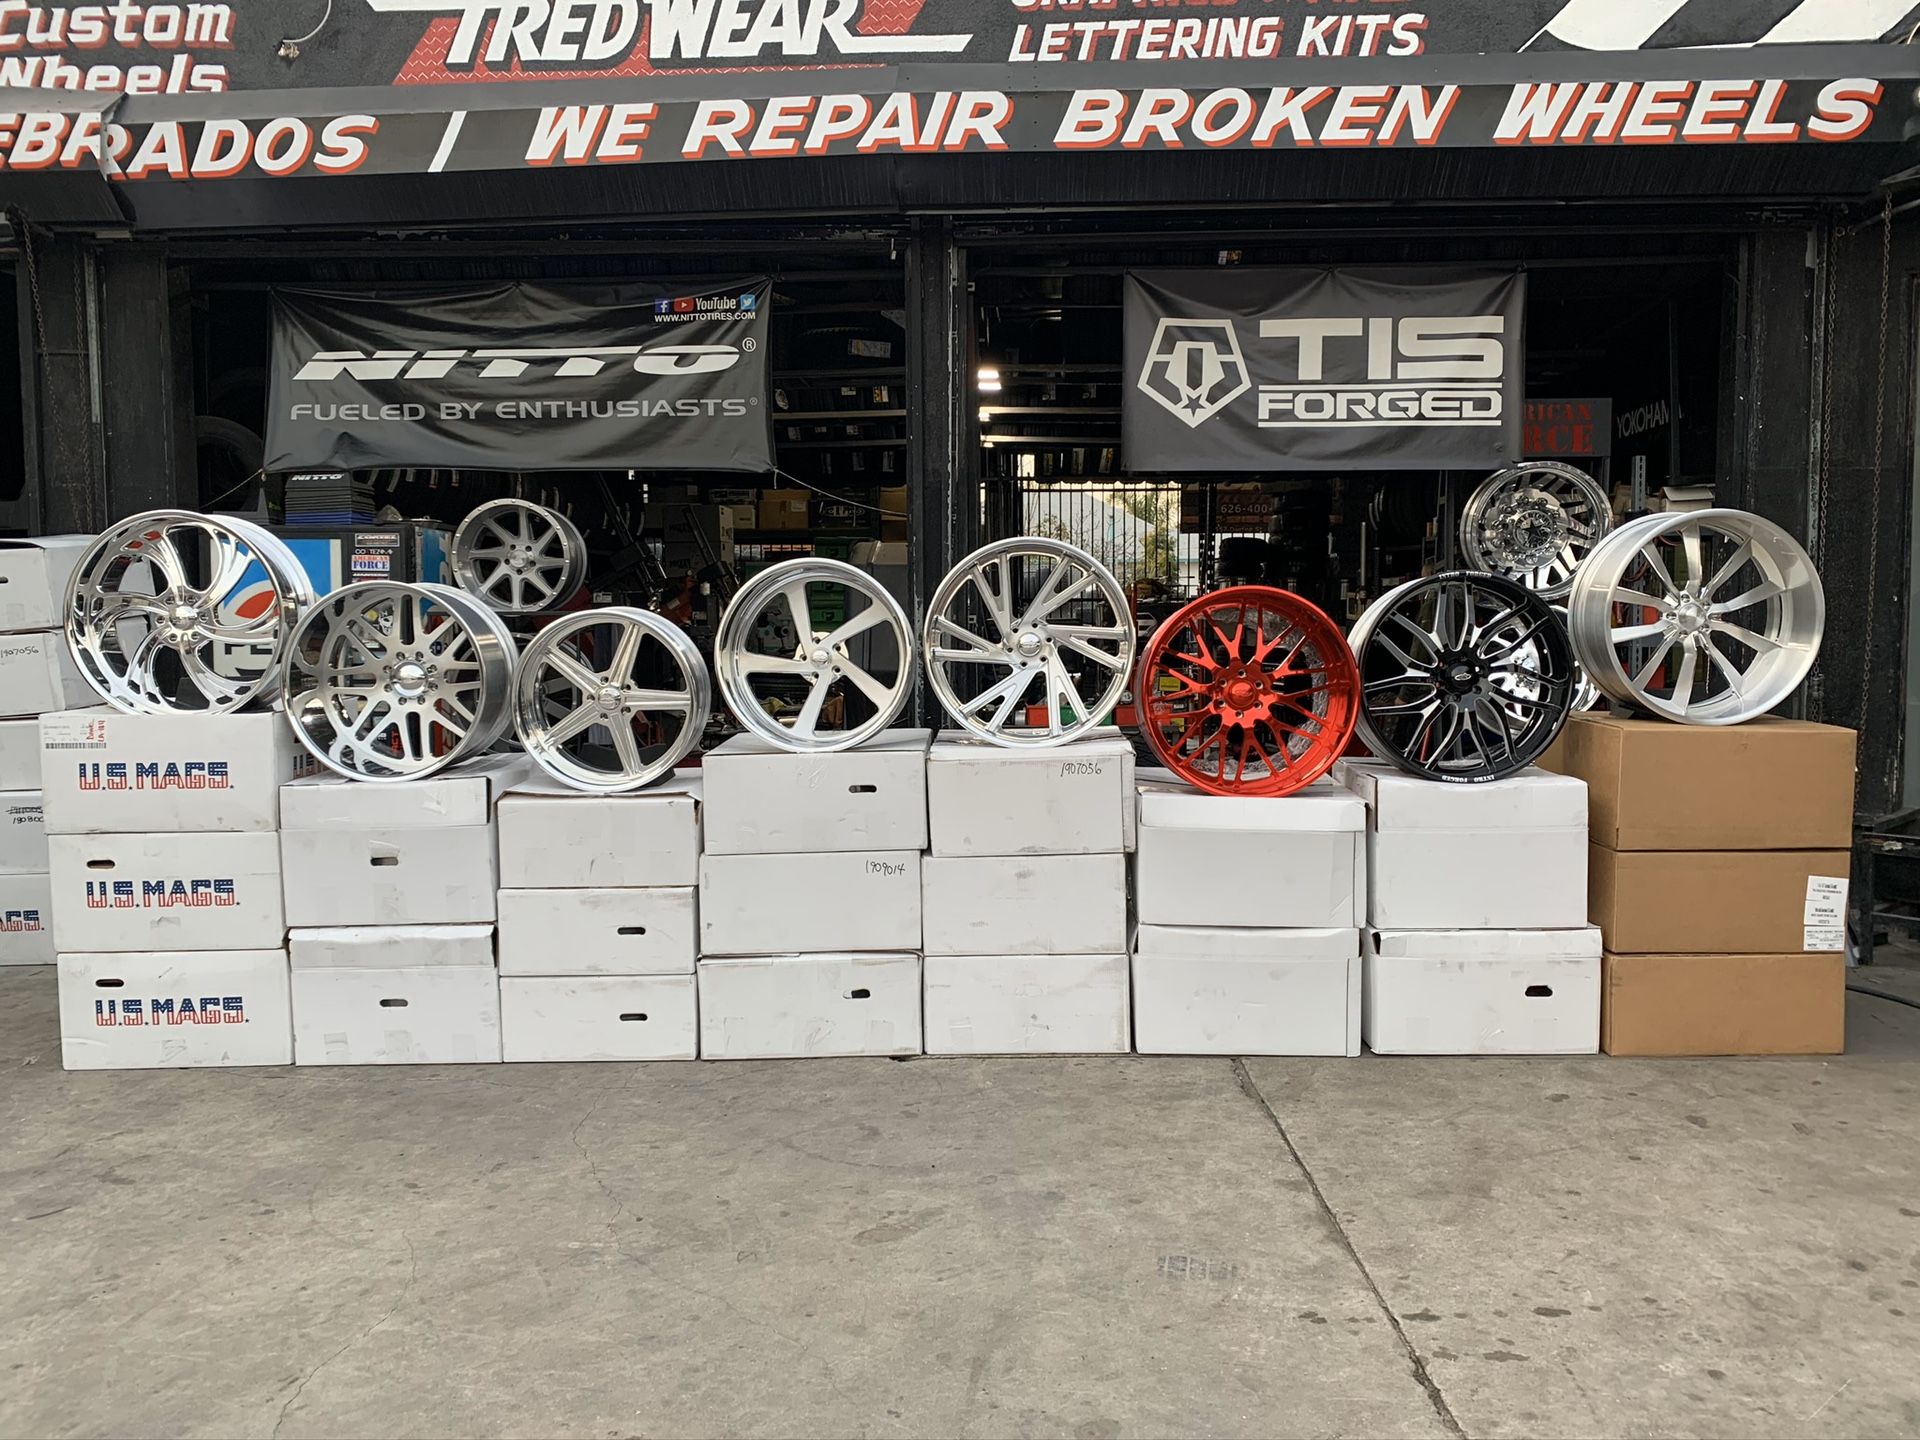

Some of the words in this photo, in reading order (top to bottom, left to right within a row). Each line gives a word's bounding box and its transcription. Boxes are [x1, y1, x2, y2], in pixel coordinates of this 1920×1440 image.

[0, 0, 235, 50] Custom
[367, 0, 973, 64] TREDWEAR
[1008, 16, 1285, 63] LETTERING
[1296, 13, 1430, 58] KITS
[0, 53, 230, 95] Wheels
[525, 103, 657, 165] WE
[681, 90, 1014, 158] REPAIR
[1053, 84, 1461, 150] BROKEN
[1492, 78, 1885, 144] WHEELS
[654, 311, 756, 323] WWW.NITTOTIRES.COM
[695, 296, 737, 310] YouTube
[292, 345, 740, 381] NITTO
[1259, 315, 1504, 381] TIS
[290, 403, 426, 421] FUELED
[439, 402, 484, 420] BY
[495, 398, 747, 419] ENTHUSIASTS
[1258, 390, 1502, 420] FORGED
[1524, 402, 1592, 421] RICAN
[1523, 424, 1595, 454] RCE
[291, 473, 345, 481] NITTO
[353, 560, 388, 570] FORCE
[1060, 762, 1102, 777] 1907056
[865, 859, 906, 876] 1909014
